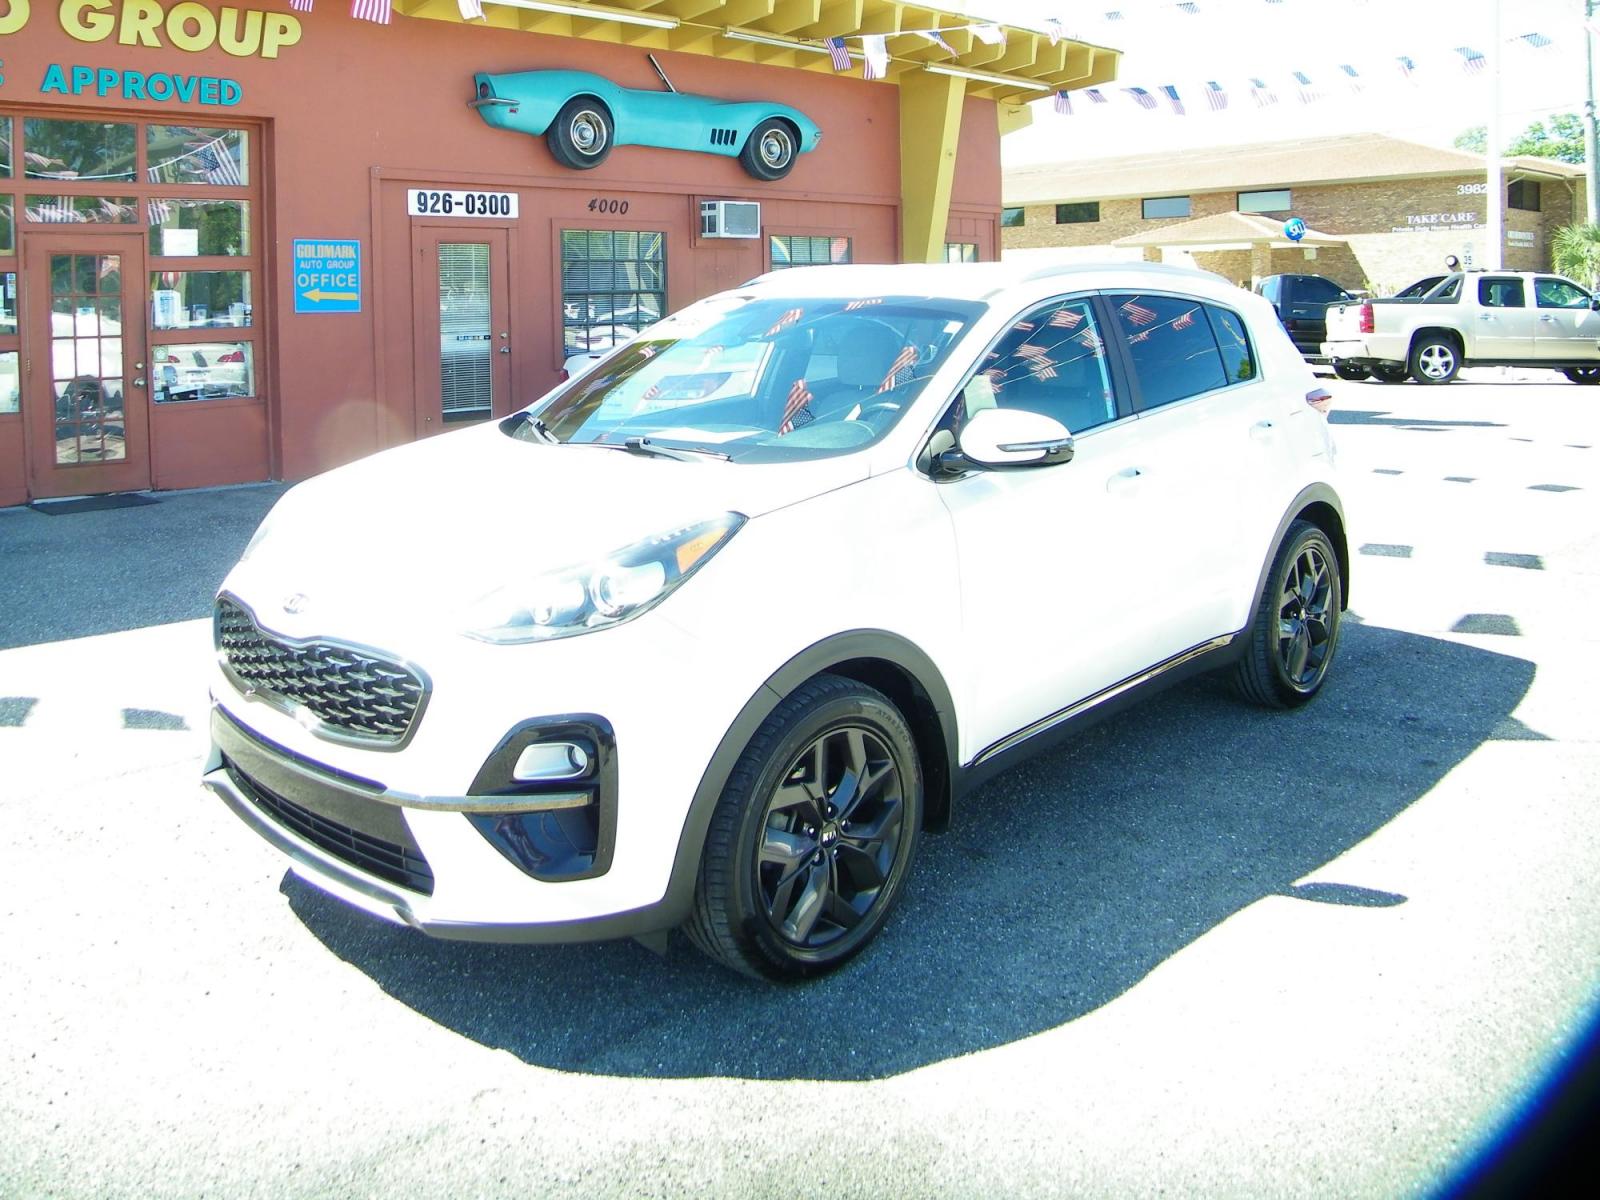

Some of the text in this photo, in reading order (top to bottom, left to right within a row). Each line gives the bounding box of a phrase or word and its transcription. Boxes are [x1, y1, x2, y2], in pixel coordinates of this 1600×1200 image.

[59, 0, 302, 59] GROUP
[41, 63, 243, 106] APPROVED
[1457, 183, 1488, 195] 3982
[417, 191, 510, 216] 926-0300
[588, 198, 629, 215] 4000
[1406, 212, 1477, 225] TAKE CARE
[297, 244, 357, 259] GOLDMARK
[300, 260, 355, 270] AUTO GROUP
[297, 273, 357, 288] OFFICE
